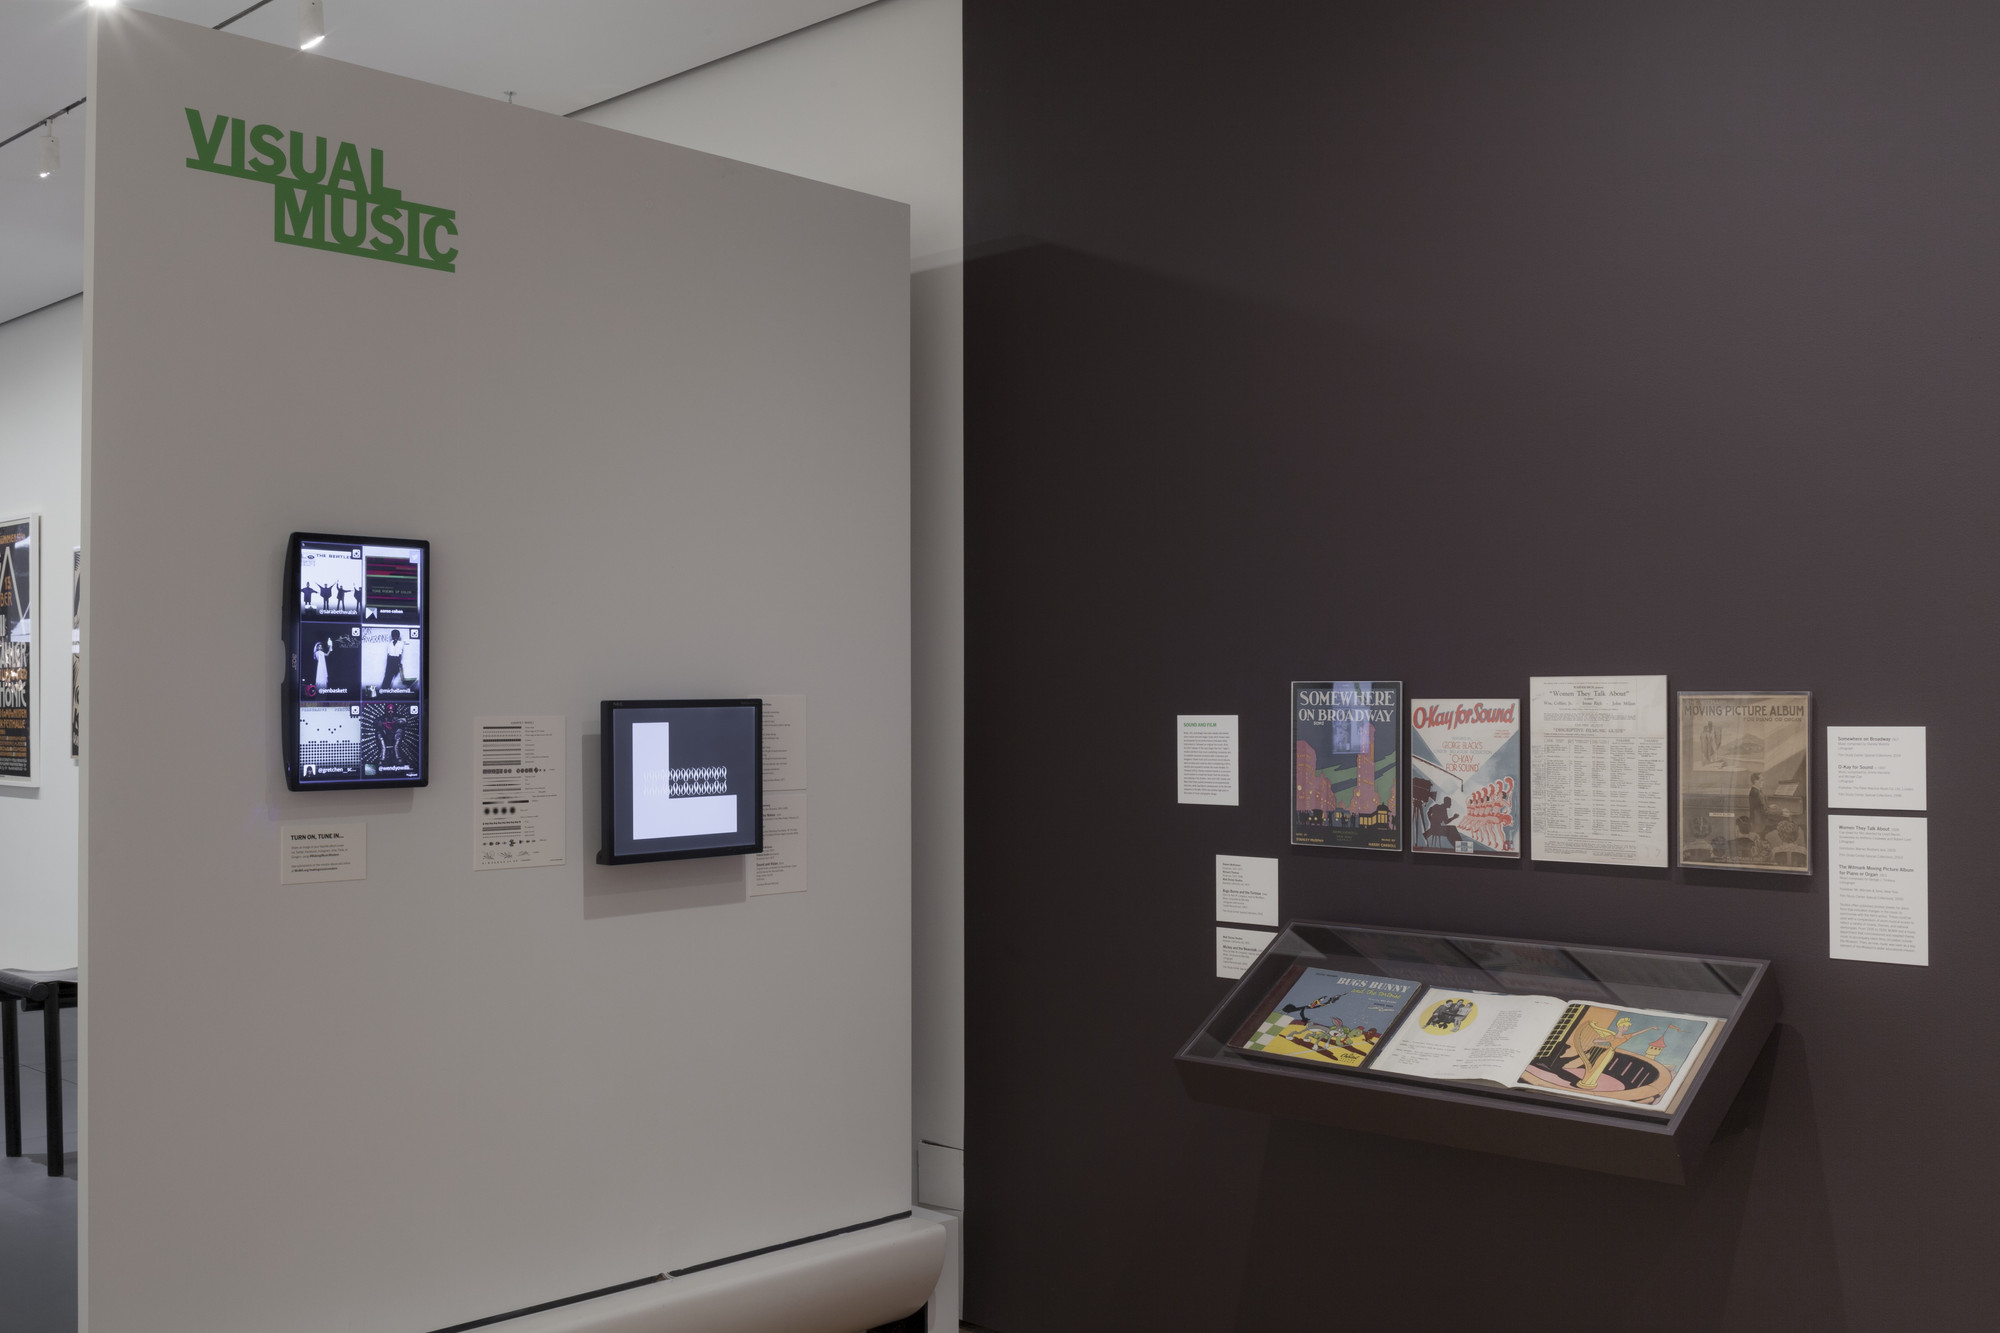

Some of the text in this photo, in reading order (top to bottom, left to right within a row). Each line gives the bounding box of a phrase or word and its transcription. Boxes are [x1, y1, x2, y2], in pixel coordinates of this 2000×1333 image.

[185, 107, 401, 201] VISUAL
[274, 184, 459, 273] MUSIC
[1300, 690, 1396, 706] SOMEWHERE
[1577, 690, 1591, 698] They
[1298, 708, 1394, 722] ON BROADWAY
[1413, 702, 1516, 730] O-Kay for Sound
[1684, 705, 1804, 717] MOVING PICTURE ALBUM
[1445, 763, 1458, 772] FOR
[1336, 977, 1410, 993] BUGS BUNNY
